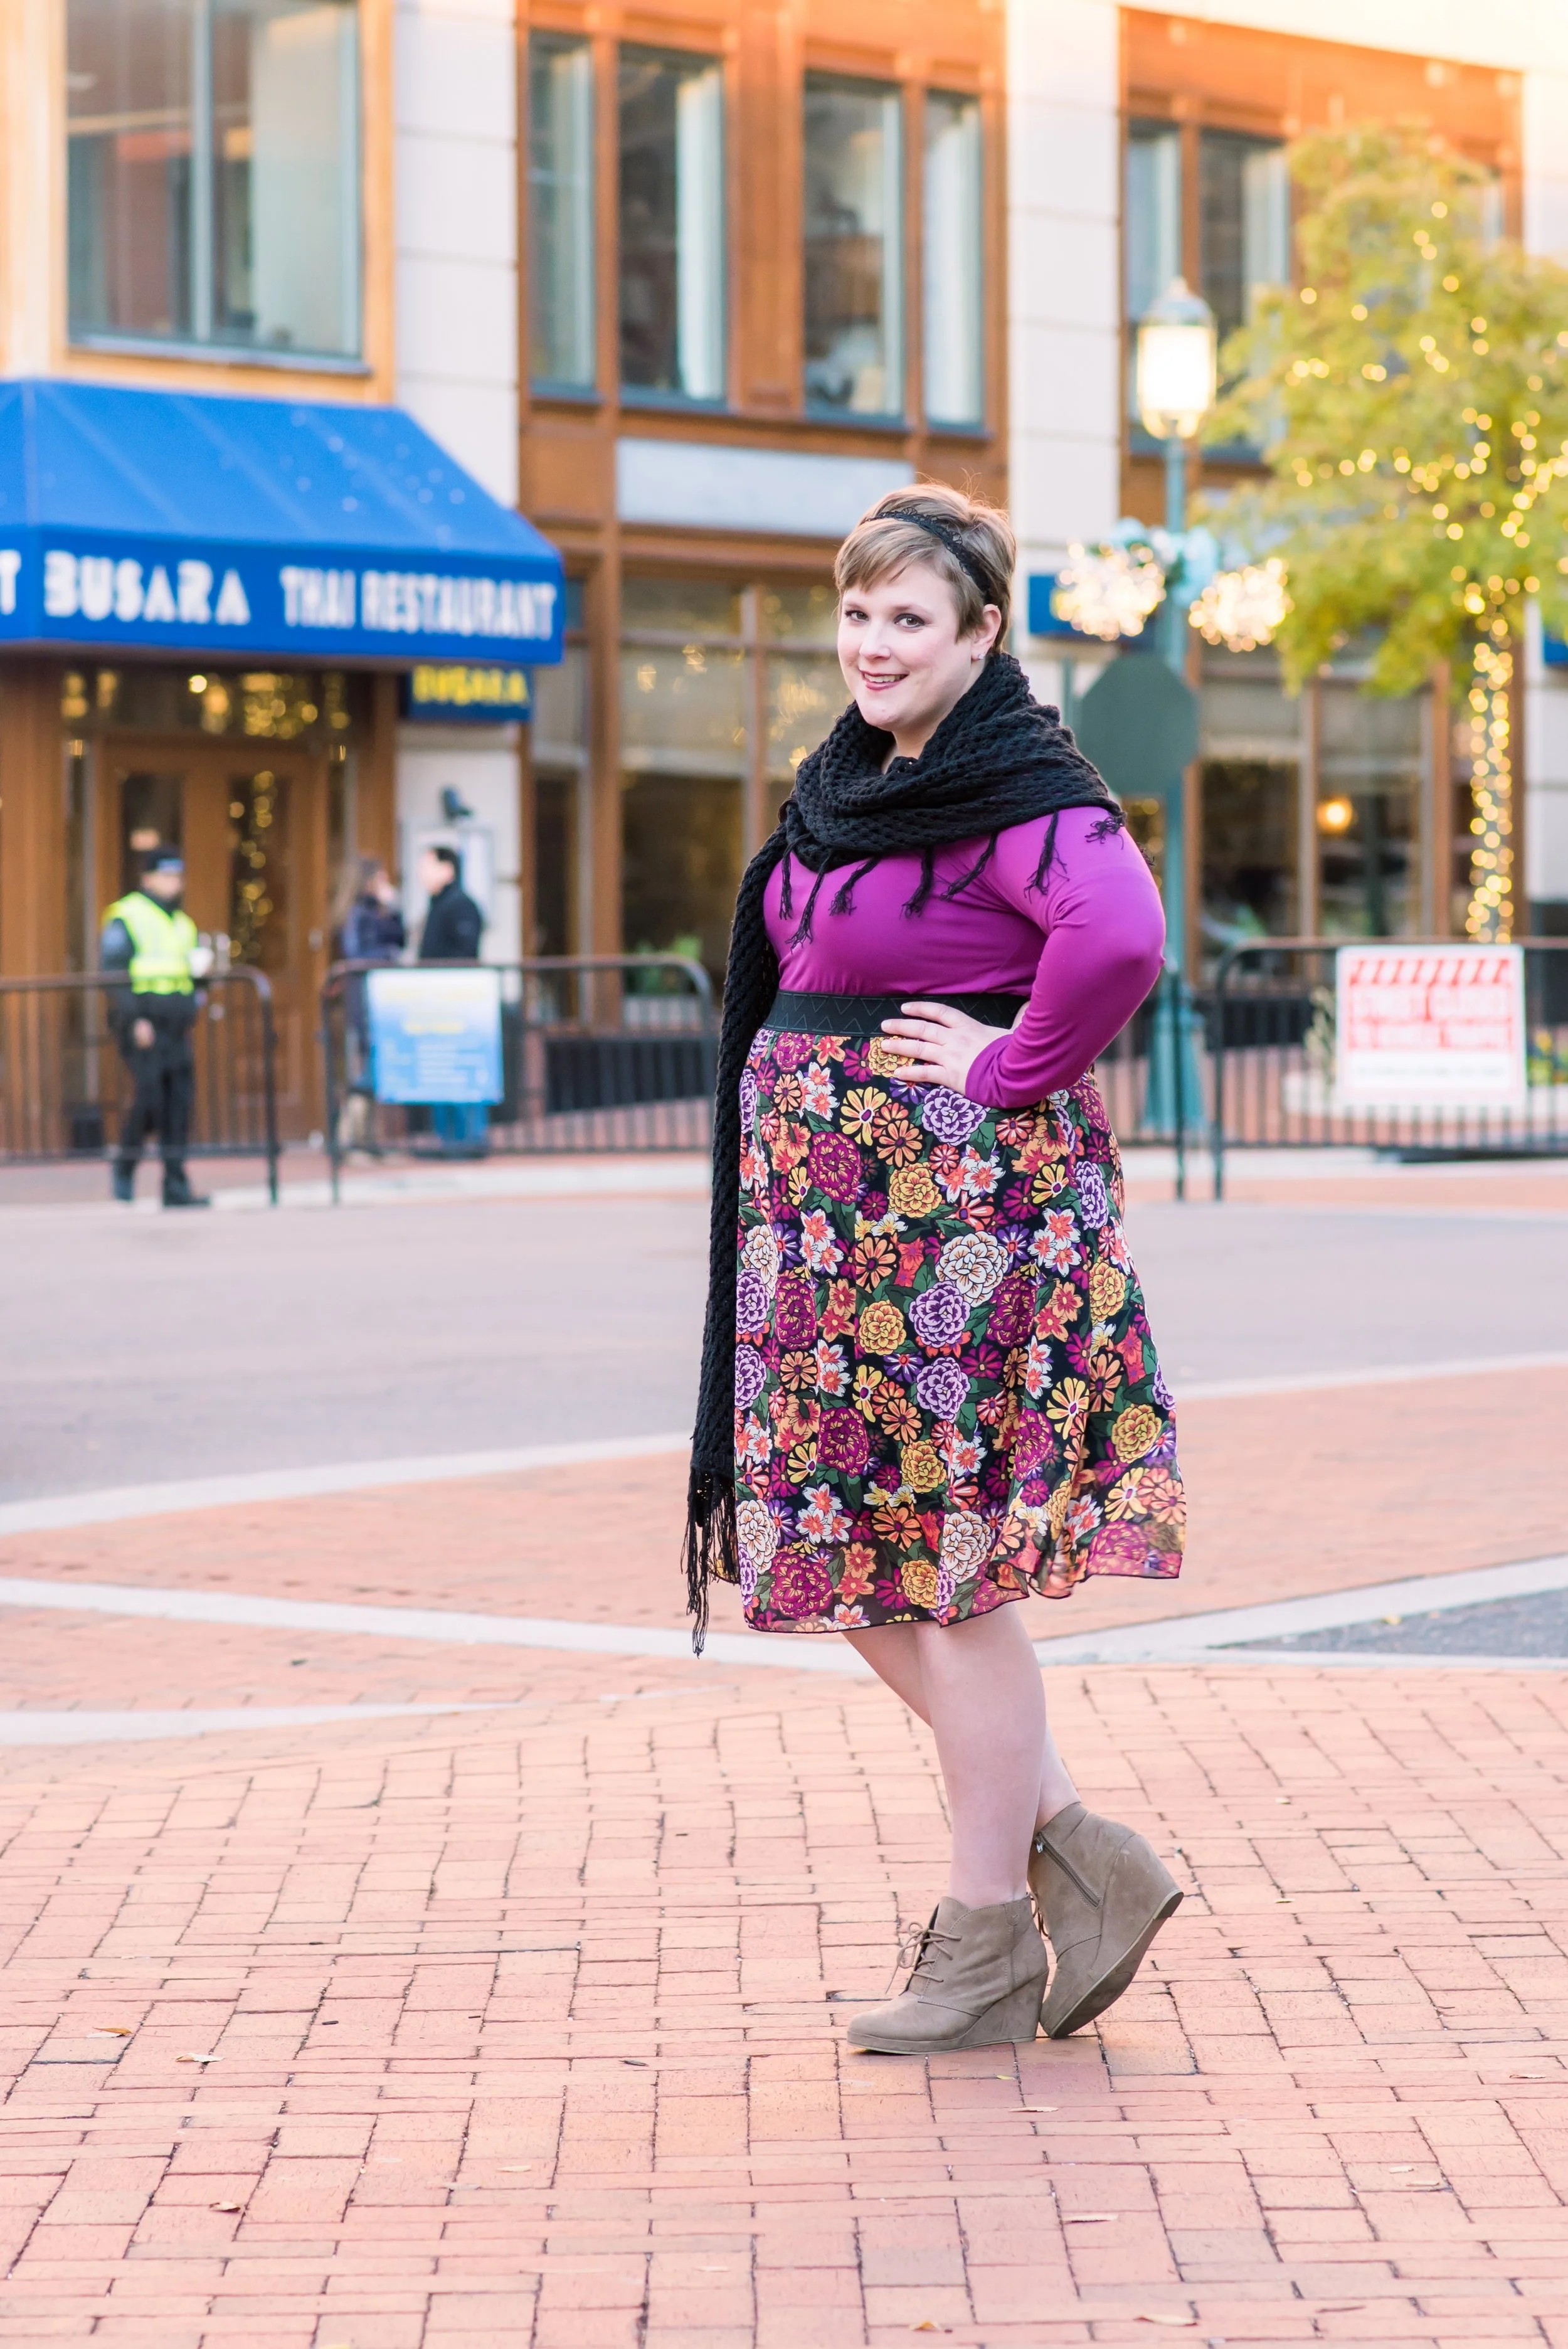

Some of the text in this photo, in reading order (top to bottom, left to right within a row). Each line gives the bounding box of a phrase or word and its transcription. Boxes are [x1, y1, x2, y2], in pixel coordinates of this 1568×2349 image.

[44, 549, 556, 641] BUSARA THAI RESTAURANT
